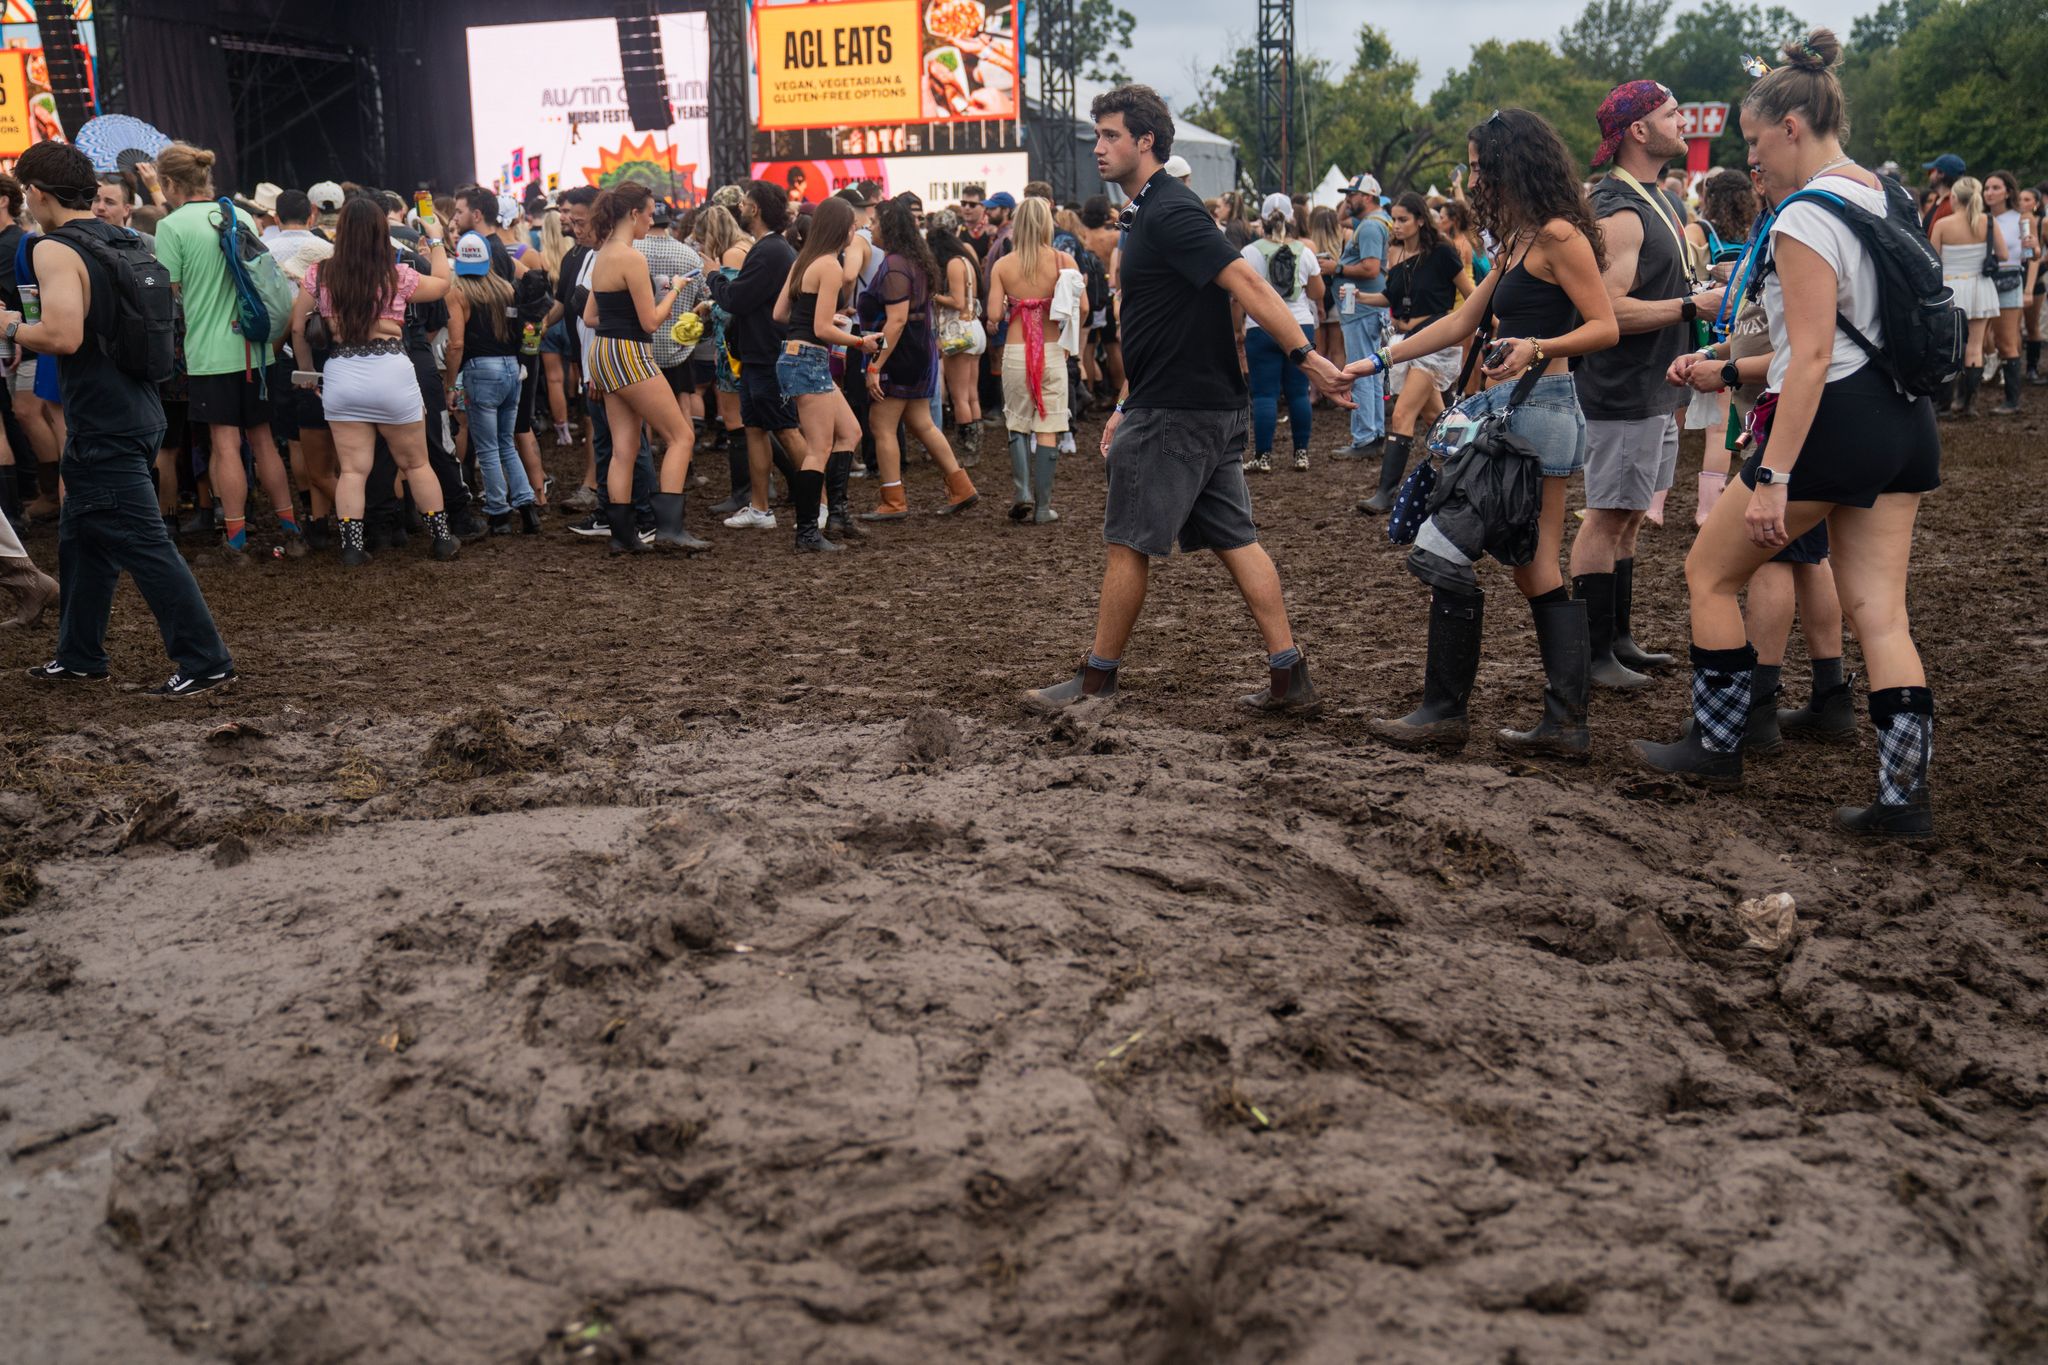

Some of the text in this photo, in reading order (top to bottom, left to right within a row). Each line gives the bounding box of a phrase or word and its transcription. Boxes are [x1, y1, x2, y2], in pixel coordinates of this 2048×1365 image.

[784, 24, 892, 69] ACL EATS
[774, 75, 902, 91] VEGAN, VEGETARIAN &
[542, 86, 610, 107] AUSTIN
[774, 87, 907, 104] GLUTEN-FREE OPTIONS
[568, 111, 600, 124] MUSIC
[929, 182, 949, 200] IT'S
